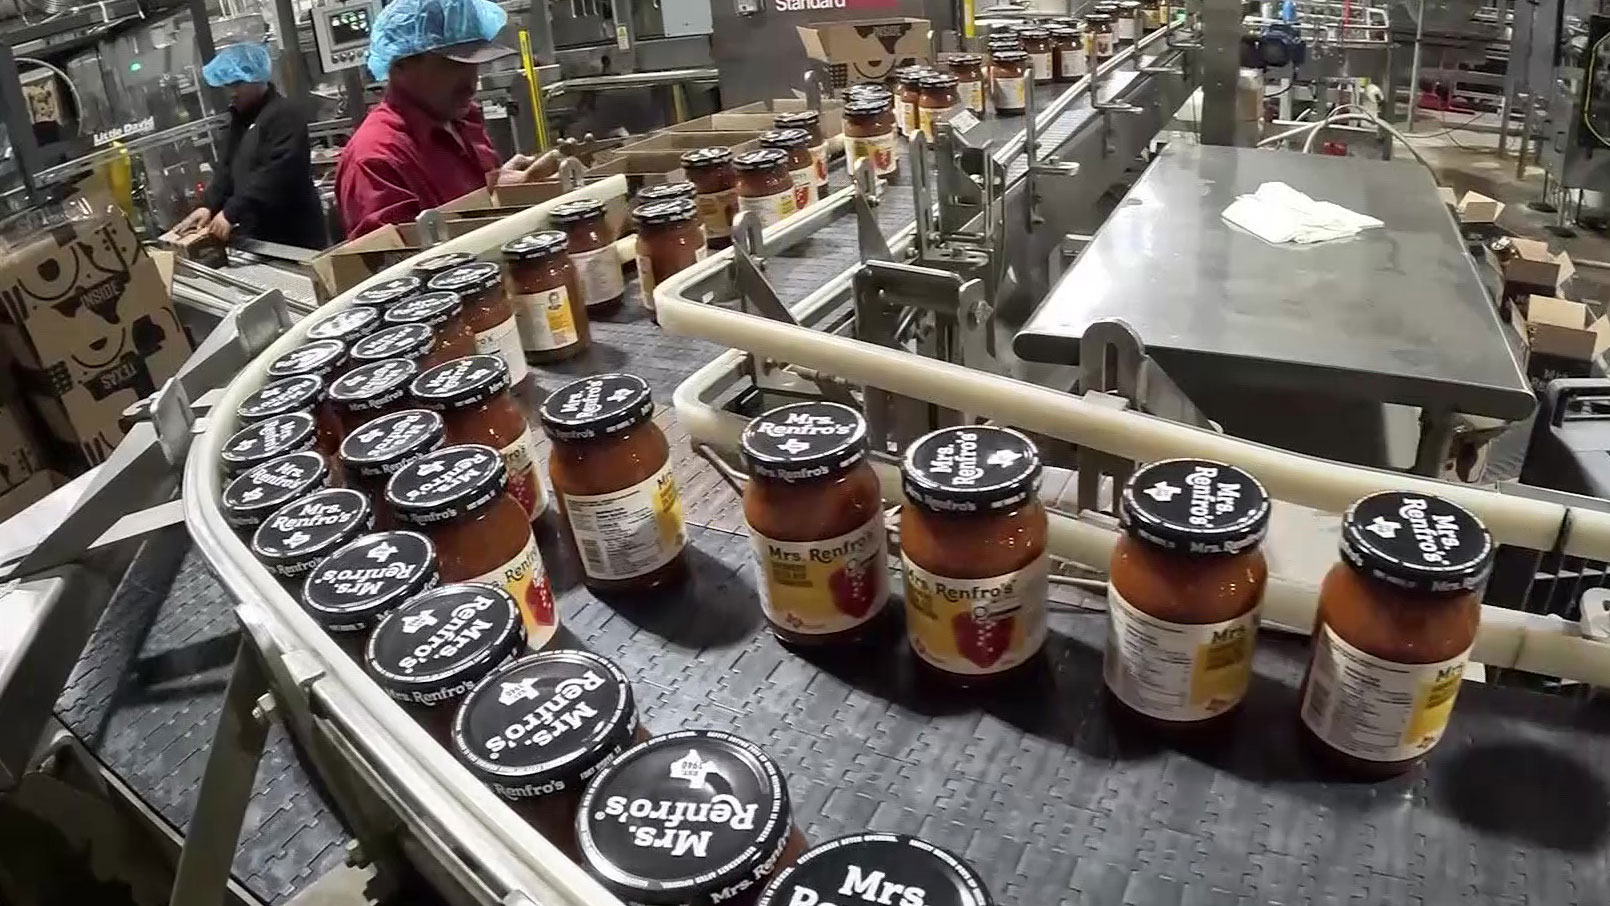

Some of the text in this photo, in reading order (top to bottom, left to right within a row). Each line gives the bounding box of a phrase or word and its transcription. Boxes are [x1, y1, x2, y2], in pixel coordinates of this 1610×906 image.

[776, 0, 846, 11] Standard
[93, 115, 154, 146] Little David
[757, 421, 851, 438] Renfro's
[784, 412, 835, 425] Mrs.
[929, 443, 955, 473] Mrs.
[951, 431, 984, 486] Renfro's
[298, 503, 341, 516] Mrs.
[1185, 466, 1218, 526] Renfro's
[1215, 482, 1241, 515] Mrs.
[270, 511, 353, 532] Renfro's
[1399, 498, 1447, 564] Renfro's
[1431, 515, 1461, 550] Mrs.
[321, 562, 417, 584] Renfro's
[334, 581, 385, 596] Mrs.
[935, 579, 1014, 603] Renfro's
[398, 595, 497, 671] Renfro's
[433, 618, 494, 660] Mrs.
[411, 680, 475, 707] Renfro's
[484, 669, 607, 756] Renfro's
[524, 701, 599, 747] Mrs.
[599, 793, 759, 830] Renfro's
[628, 825, 713, 858] Mrs.
[710, 879, 753, 905] Mrs.
[838, 864, 930, 906] Mrs
